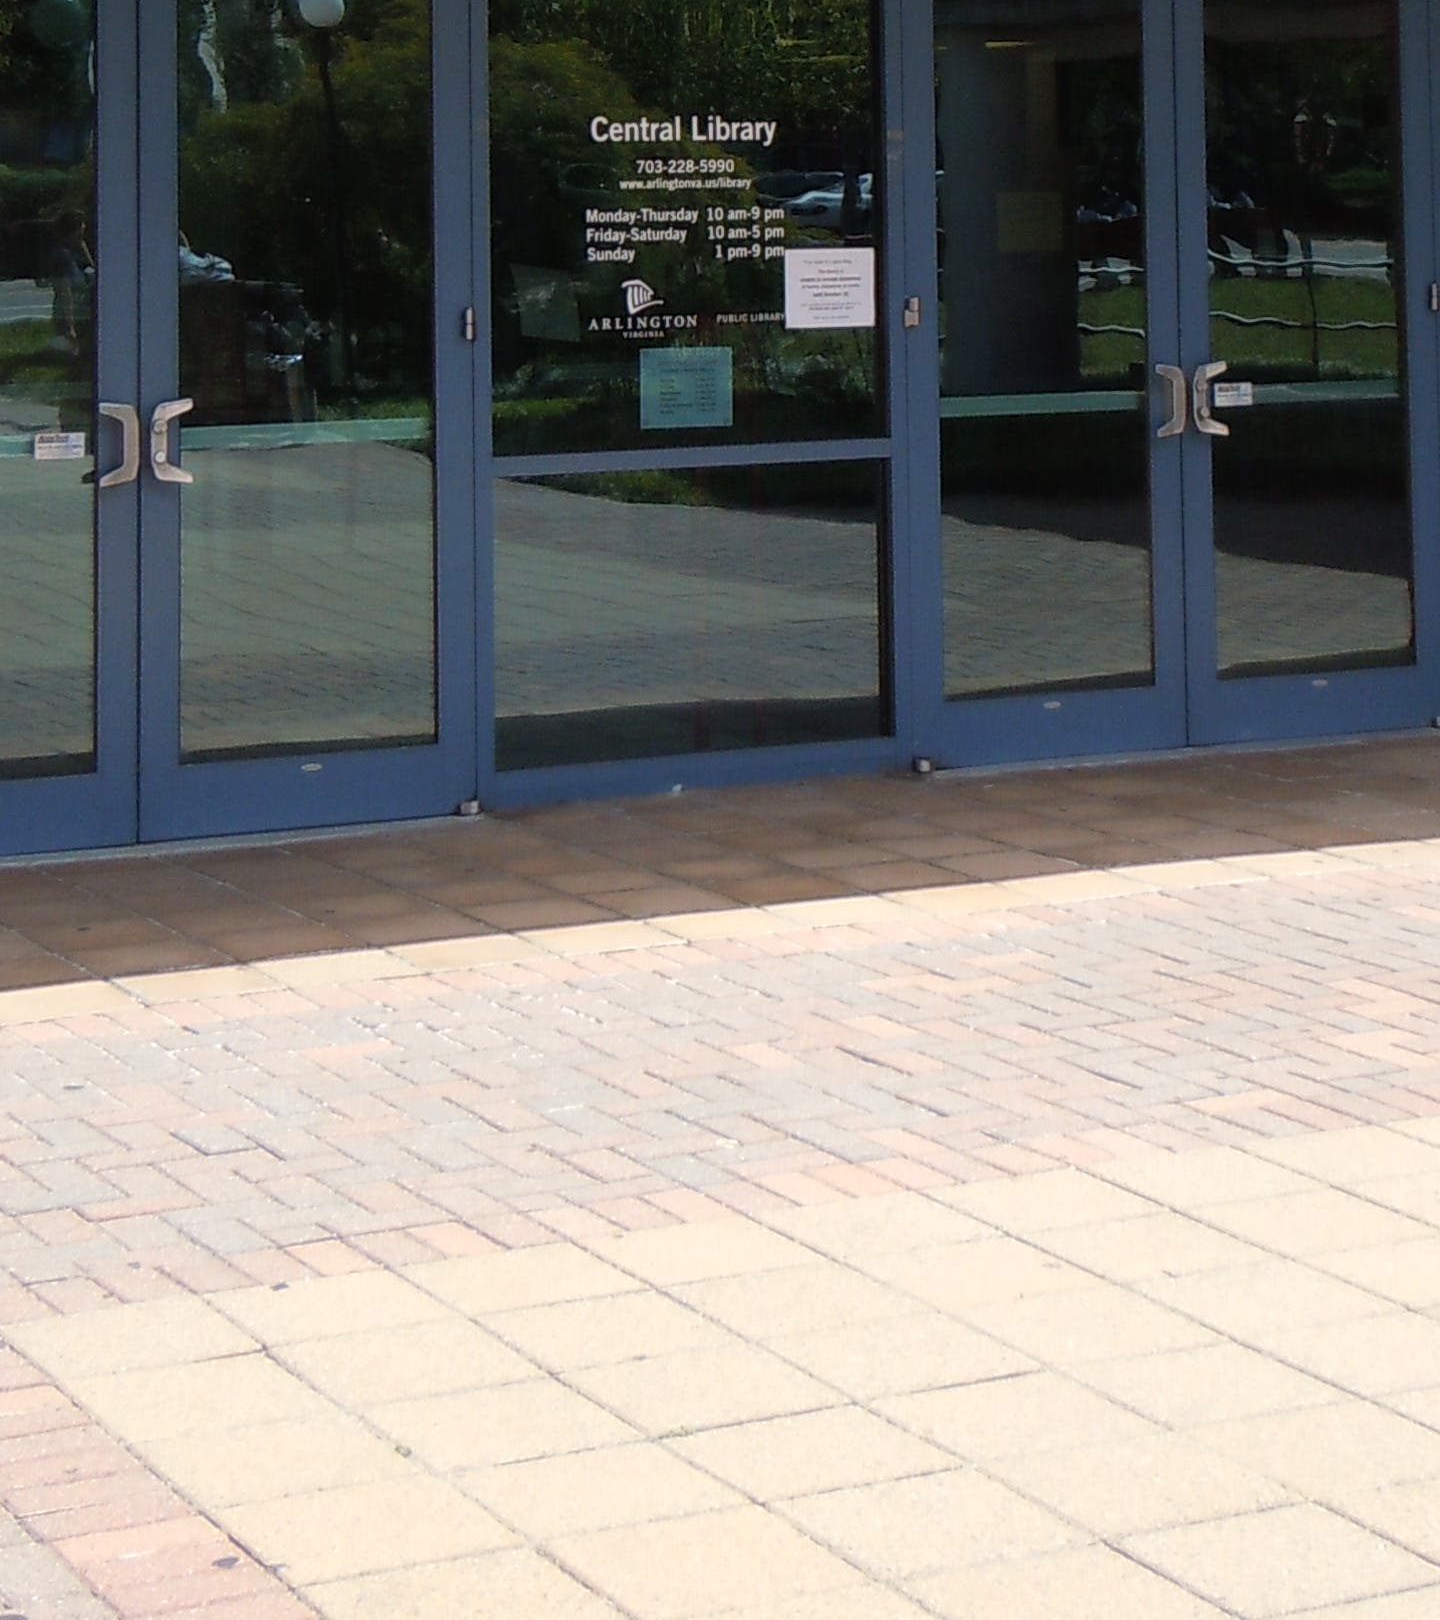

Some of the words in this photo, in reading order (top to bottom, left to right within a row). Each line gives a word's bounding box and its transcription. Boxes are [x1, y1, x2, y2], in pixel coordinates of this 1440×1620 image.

[590, 115, 681, 143] Central
[691, 115, 778, 147] Library
[636, 159, 735, 175] 703-228-5990
[619, 177, 752, 191] www.arlingtonva.us/library
[585, 207, 699, 225] Monday-Thursday
[707, 207, 723, 221] 10
[727, 207, 760, 221] am-9
[764, 208, 785, 223] pm
[585, 227, 687, 244] Friday-Saturday
[707, 226, 723, 240] 10
[727, 226, 761, 239] am-5
[764, 227, 785, 242] pm
[587, 247, 636, 263] Sunday
[715, 245, 723, 259] 1
[727, 245, 760, 261] pm-9
[764, 246, 786, 260] pm
[588, 314, 698, 331] ARLINGTON
[716, 313, 748, 324] PUBLIC
[749, 311, 785, 323] LIBRARY
[622, 331, 665, 340] VIRGINIA
